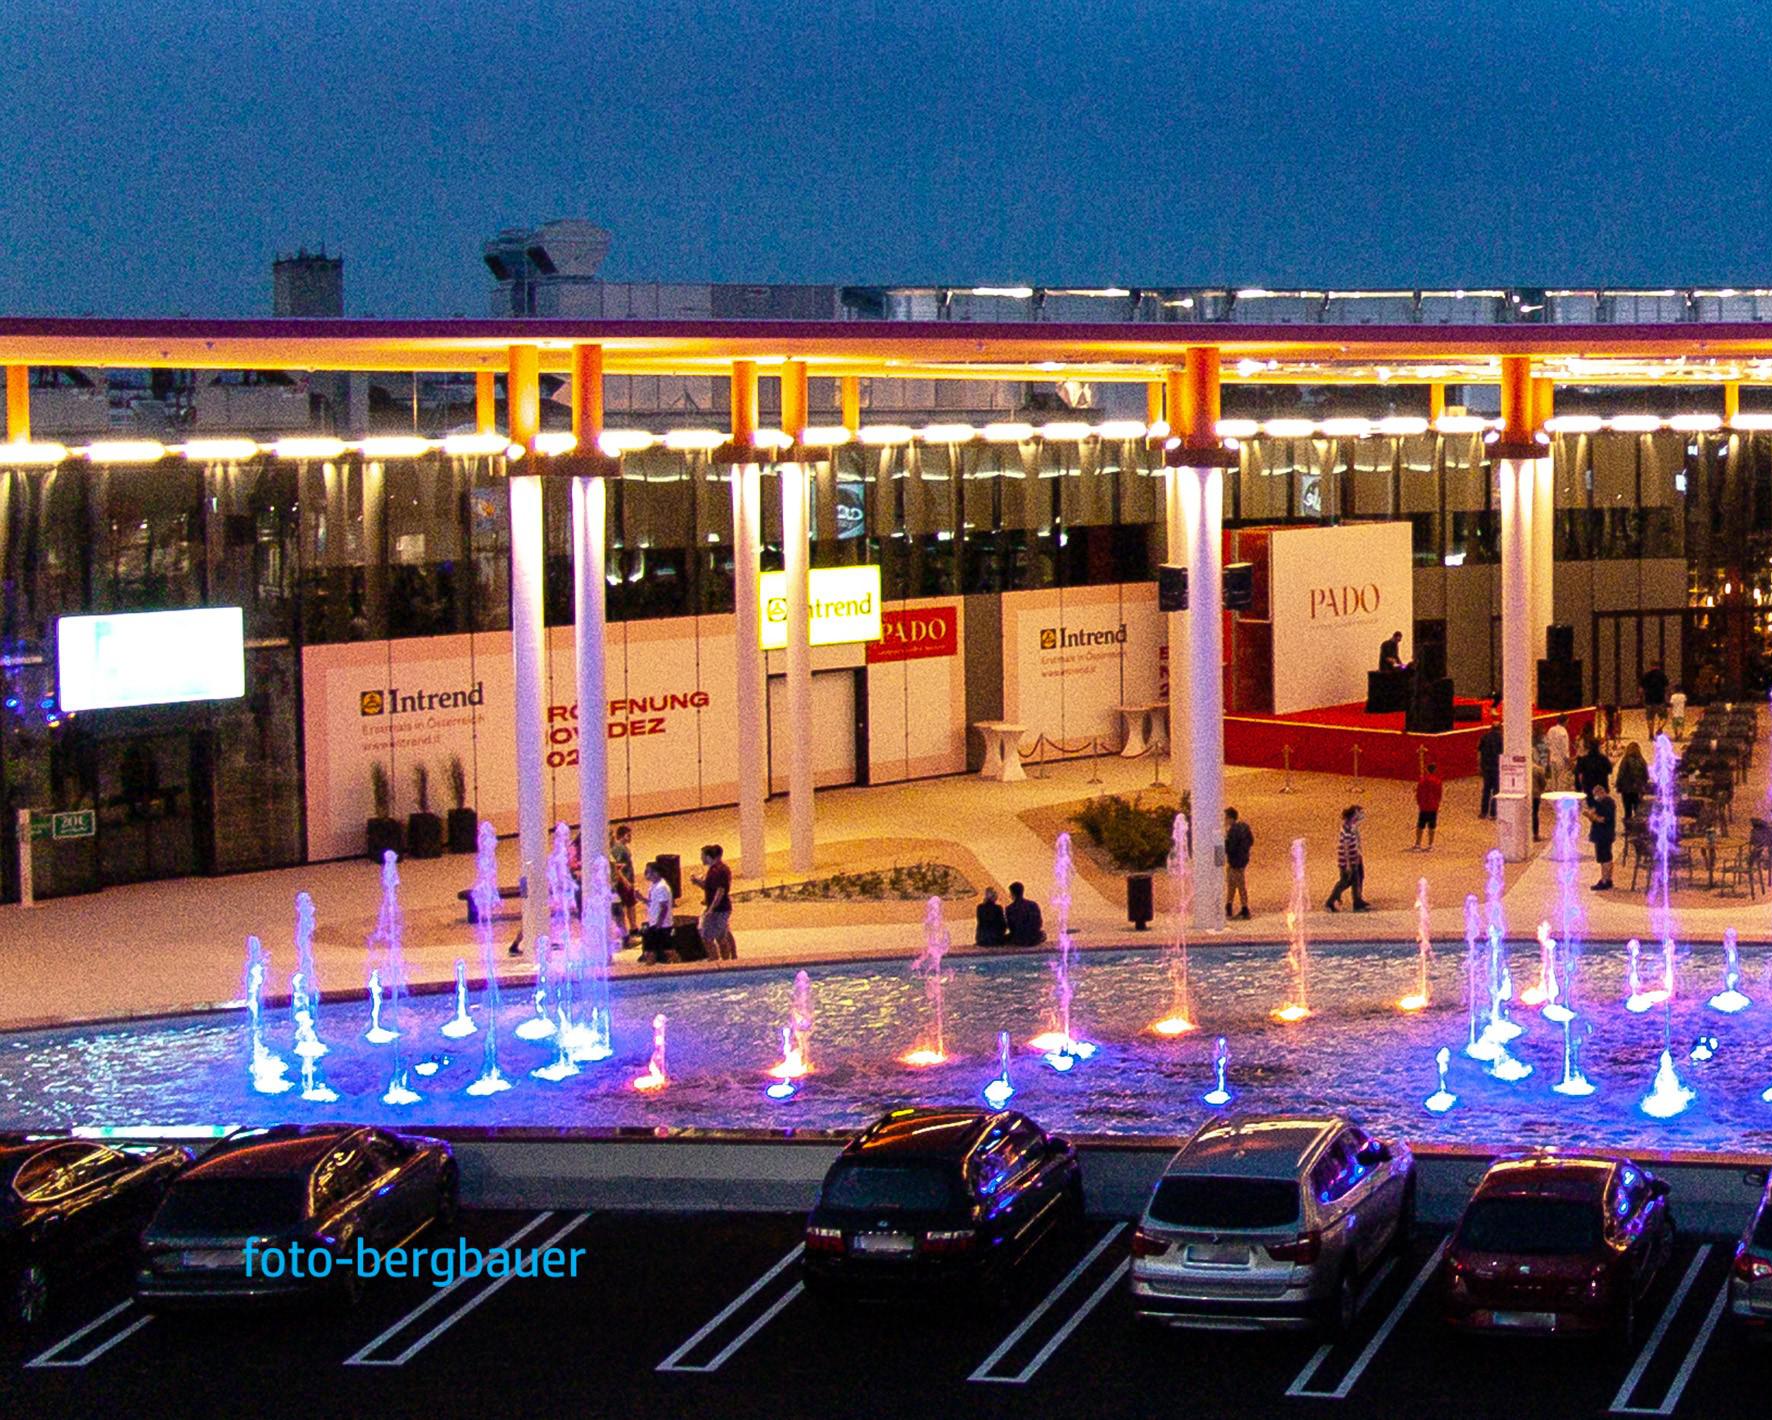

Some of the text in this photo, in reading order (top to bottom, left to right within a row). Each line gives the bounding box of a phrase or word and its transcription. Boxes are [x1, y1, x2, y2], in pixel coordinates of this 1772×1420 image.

[808, 592, 872, 619] ntrend
[1310, 584, 1380, 620] PADO
[879, 617, 947, 645] PADO
[1060, 624, 1128, 649] Intrend
[389, 681, 484, 715] Intrend
[608, 717, 666, 739] DEZ
